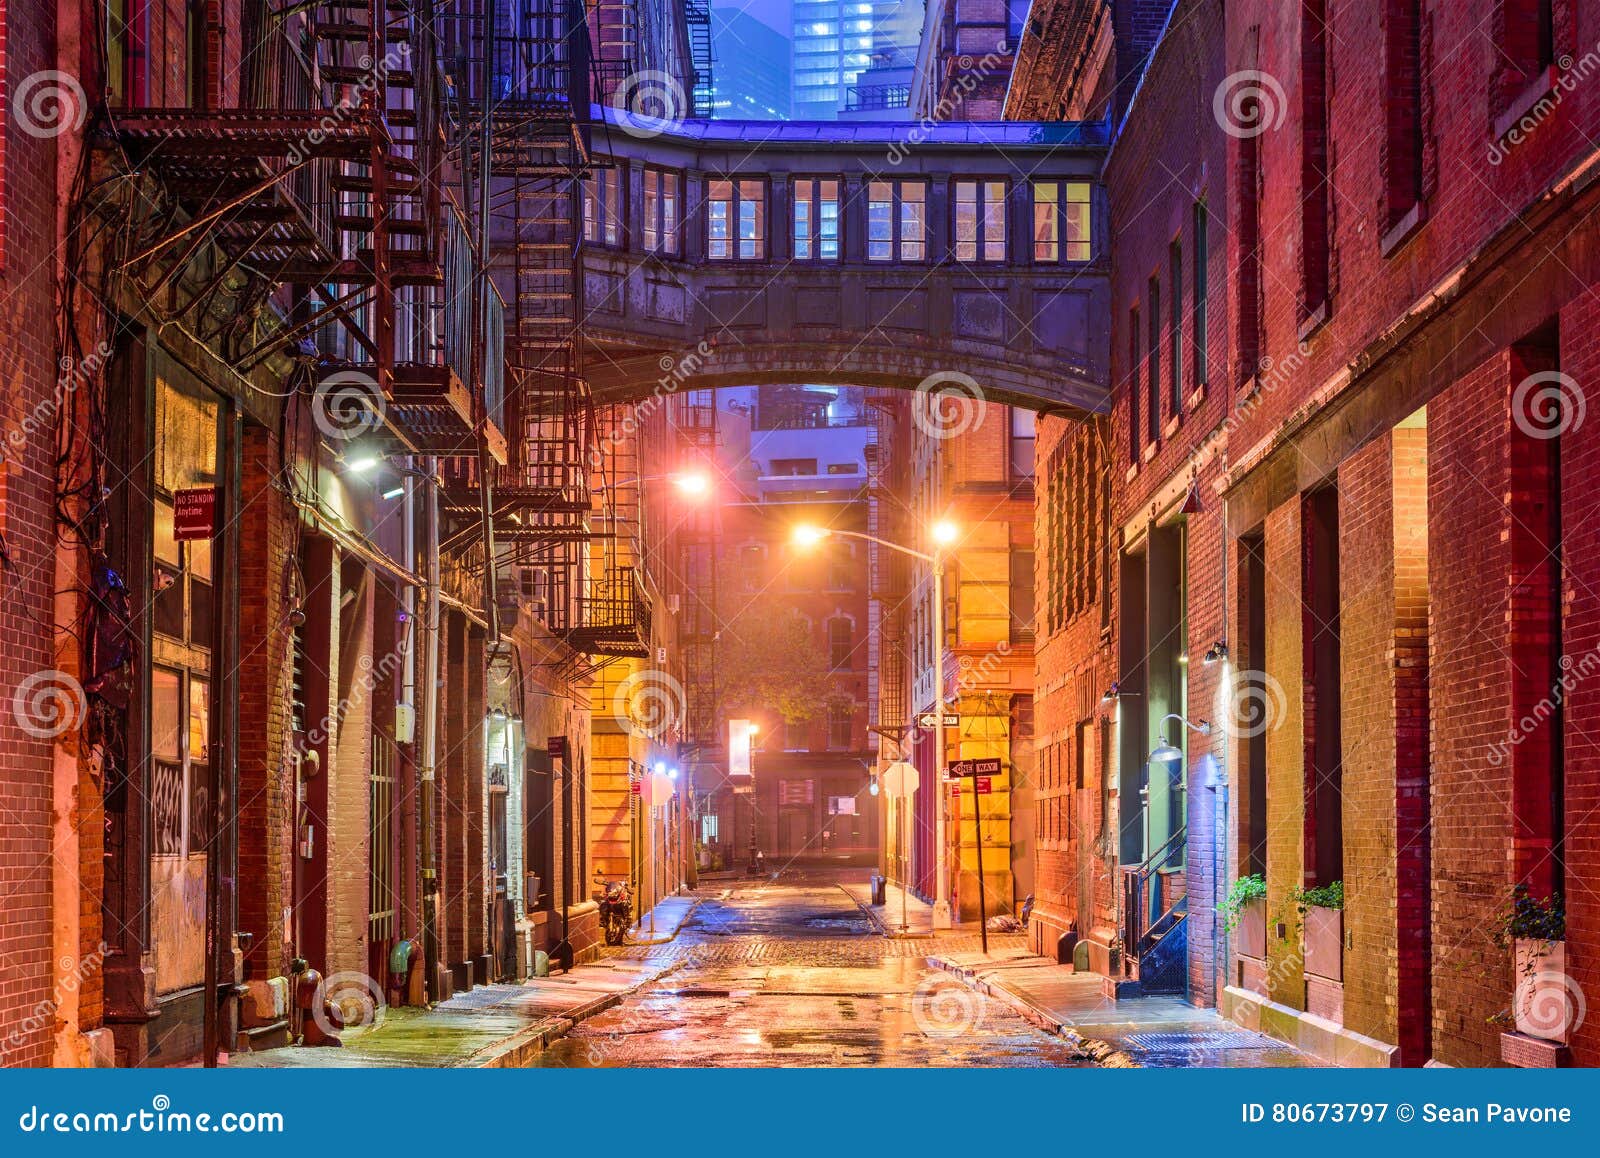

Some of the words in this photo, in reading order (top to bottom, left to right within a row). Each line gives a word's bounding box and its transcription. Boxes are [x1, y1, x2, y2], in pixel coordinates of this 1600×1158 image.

[177, 495, 187, 505] NO
[177, 506, 203, 518] Anytime
[957, 763, 973, 773] ONE
[979, 763, 994, 771] WAY
